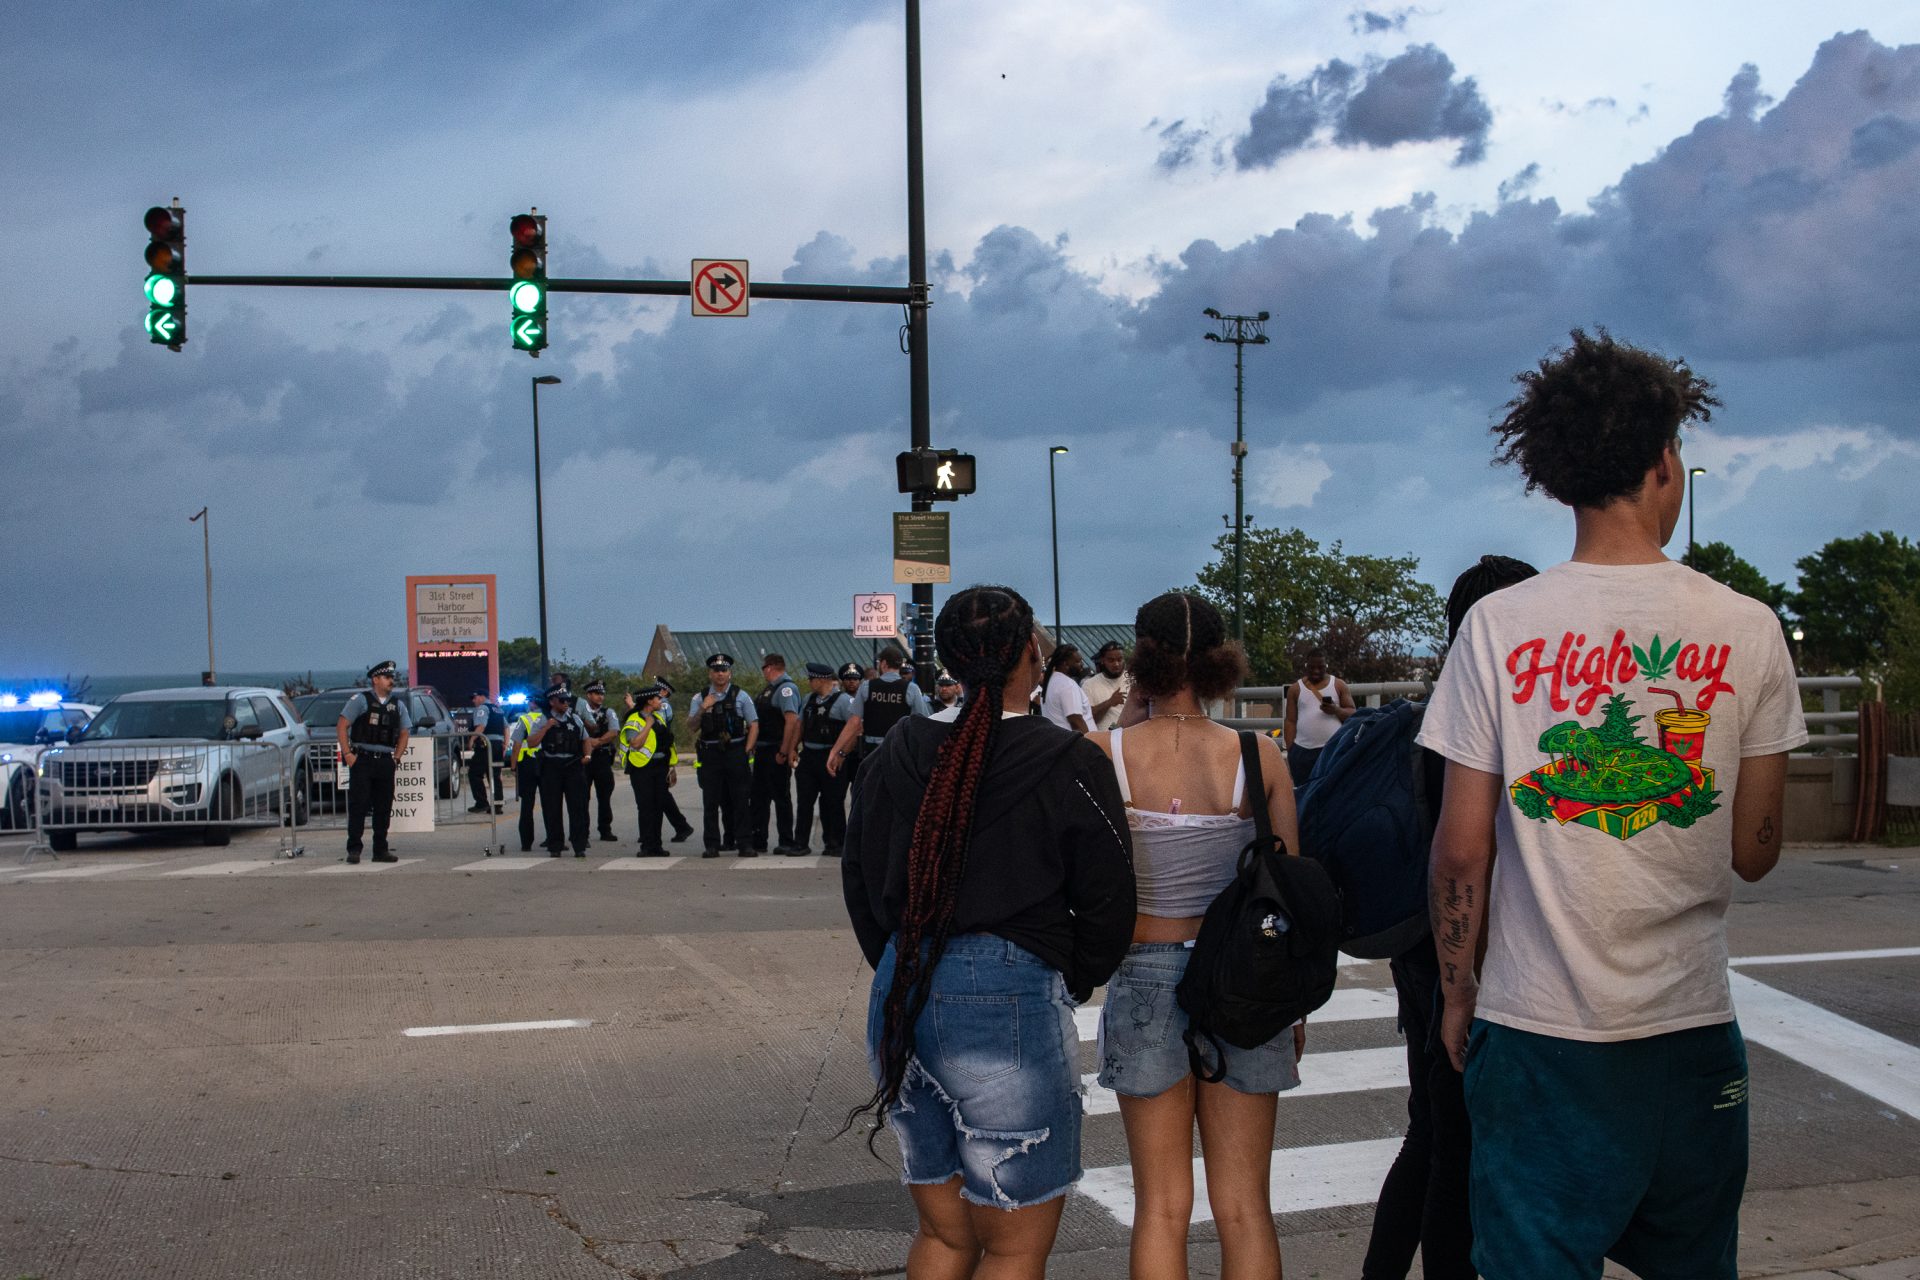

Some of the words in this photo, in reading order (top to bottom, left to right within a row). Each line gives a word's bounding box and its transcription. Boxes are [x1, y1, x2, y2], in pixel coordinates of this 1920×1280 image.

[429, 591, 445, 601] 31st
[449, 590, 474, 601] Street
[437, 602, 465, 612] Harbor
[420, 615, 446, 625] Margaret
[453, 615, 484, 625] Burroughs
[860, 615, 874, 623] MAY
[876, 615, 889, 623] USE
[432, 627, 450, 637] Beach
[459, 627, 472, 636] Park
[857, 624, 873, 632] FULL
[876, 624, 893, 632] LANE
[871, 691, 903, 704] POLICE
[396, 777, 427, 787] RBOR
[1631, 805, 1658, 831] 420
